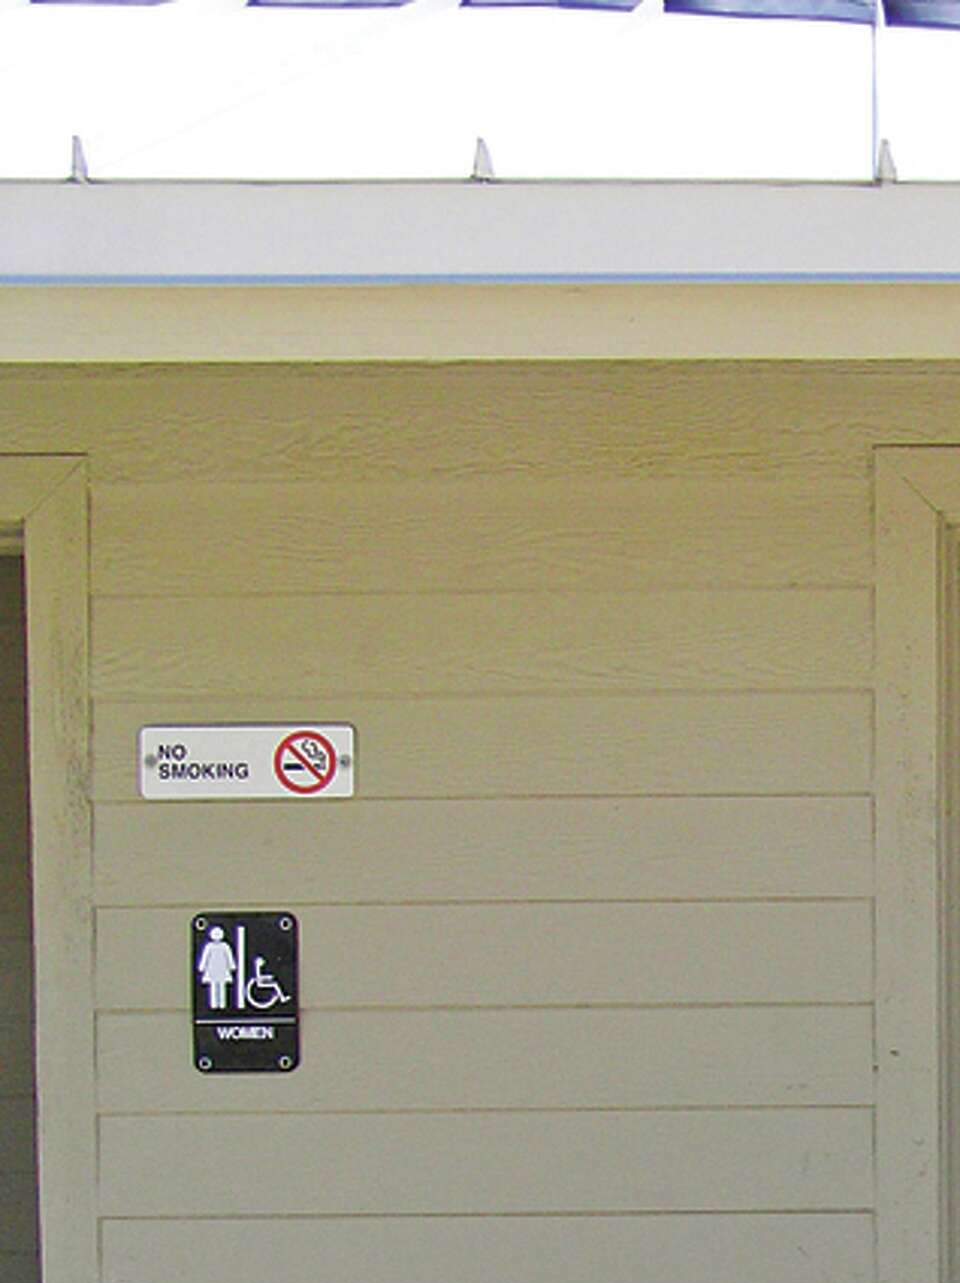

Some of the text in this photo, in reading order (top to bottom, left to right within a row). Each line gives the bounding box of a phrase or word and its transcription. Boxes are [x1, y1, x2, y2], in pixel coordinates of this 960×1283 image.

[157, 744, 187, 761] NO
[158, 763, 249, 780] SMOKING
[216, 1026, 274, 1040] WOMEN
